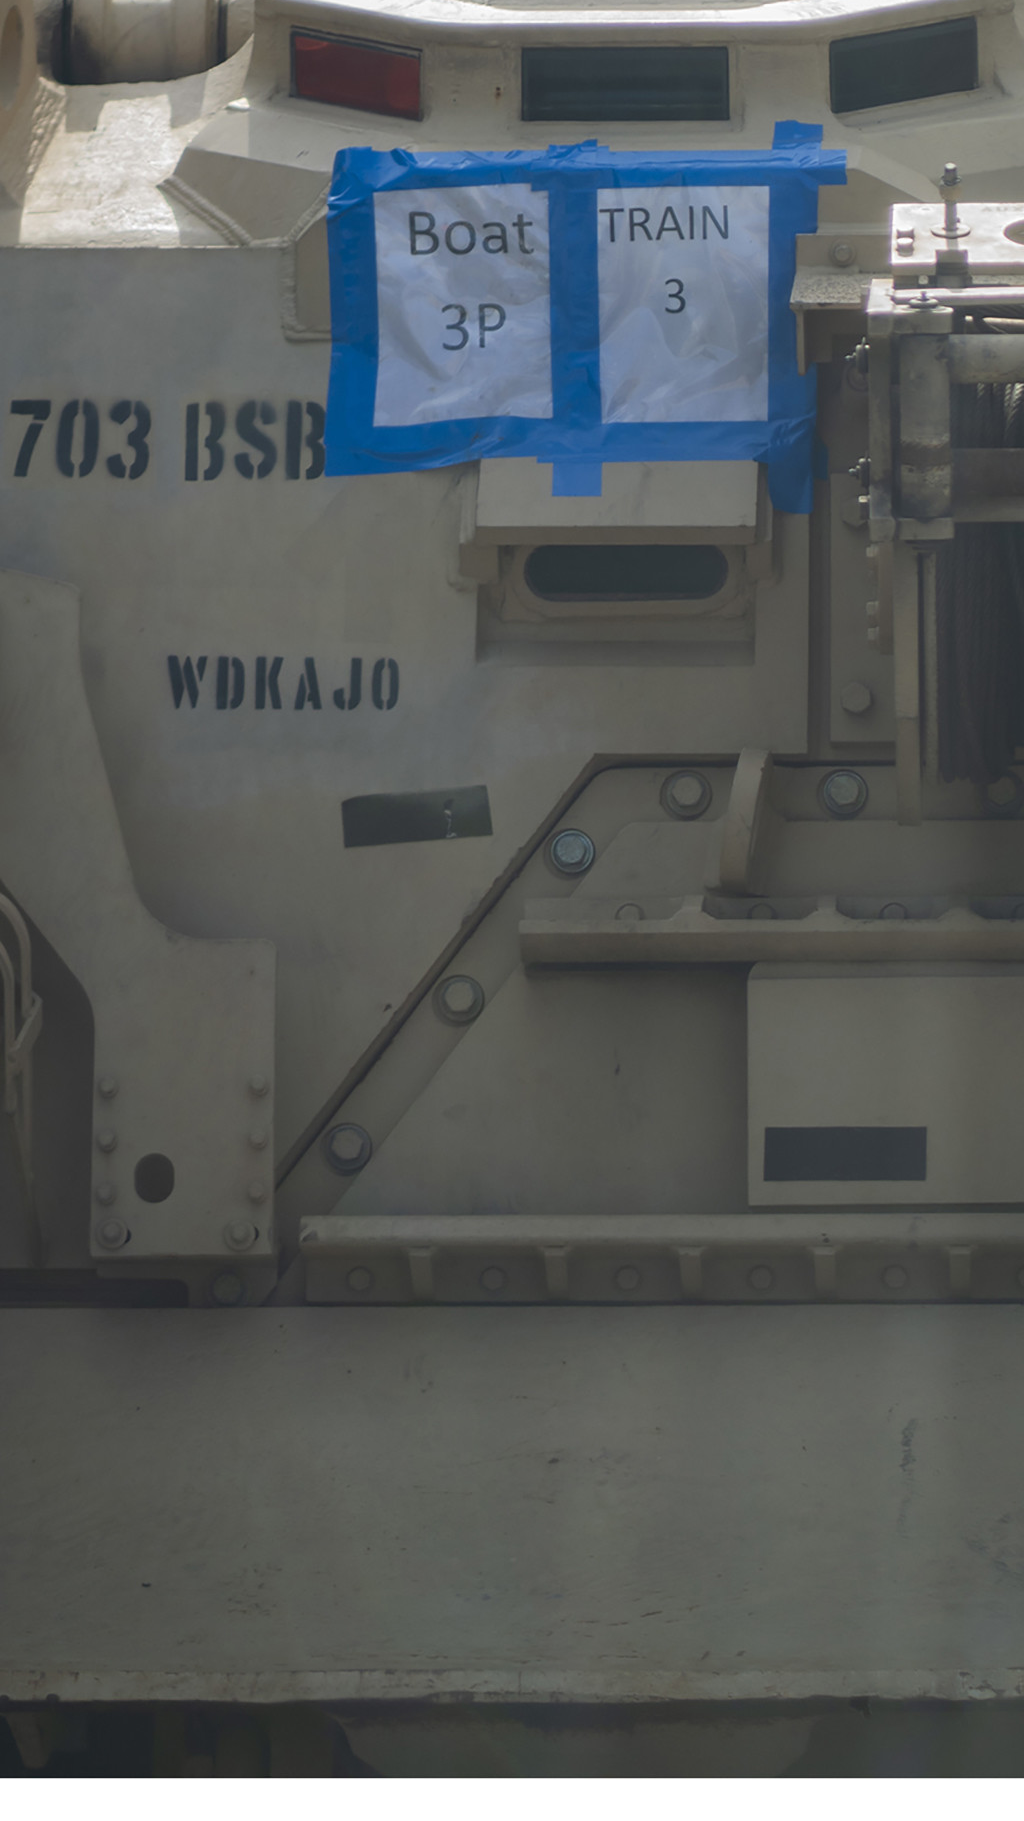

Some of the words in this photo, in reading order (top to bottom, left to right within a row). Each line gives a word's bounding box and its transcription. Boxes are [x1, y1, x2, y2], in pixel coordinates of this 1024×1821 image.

[408, 211, 535, 256] Boat
[599, 205, 729, 243] TRAIN
[664, 278, 687, 314] 3
[441, 303, 507, 351] 3P
[10, 399, 151, 481] 703
[184, 399, 326, 481] BSB
